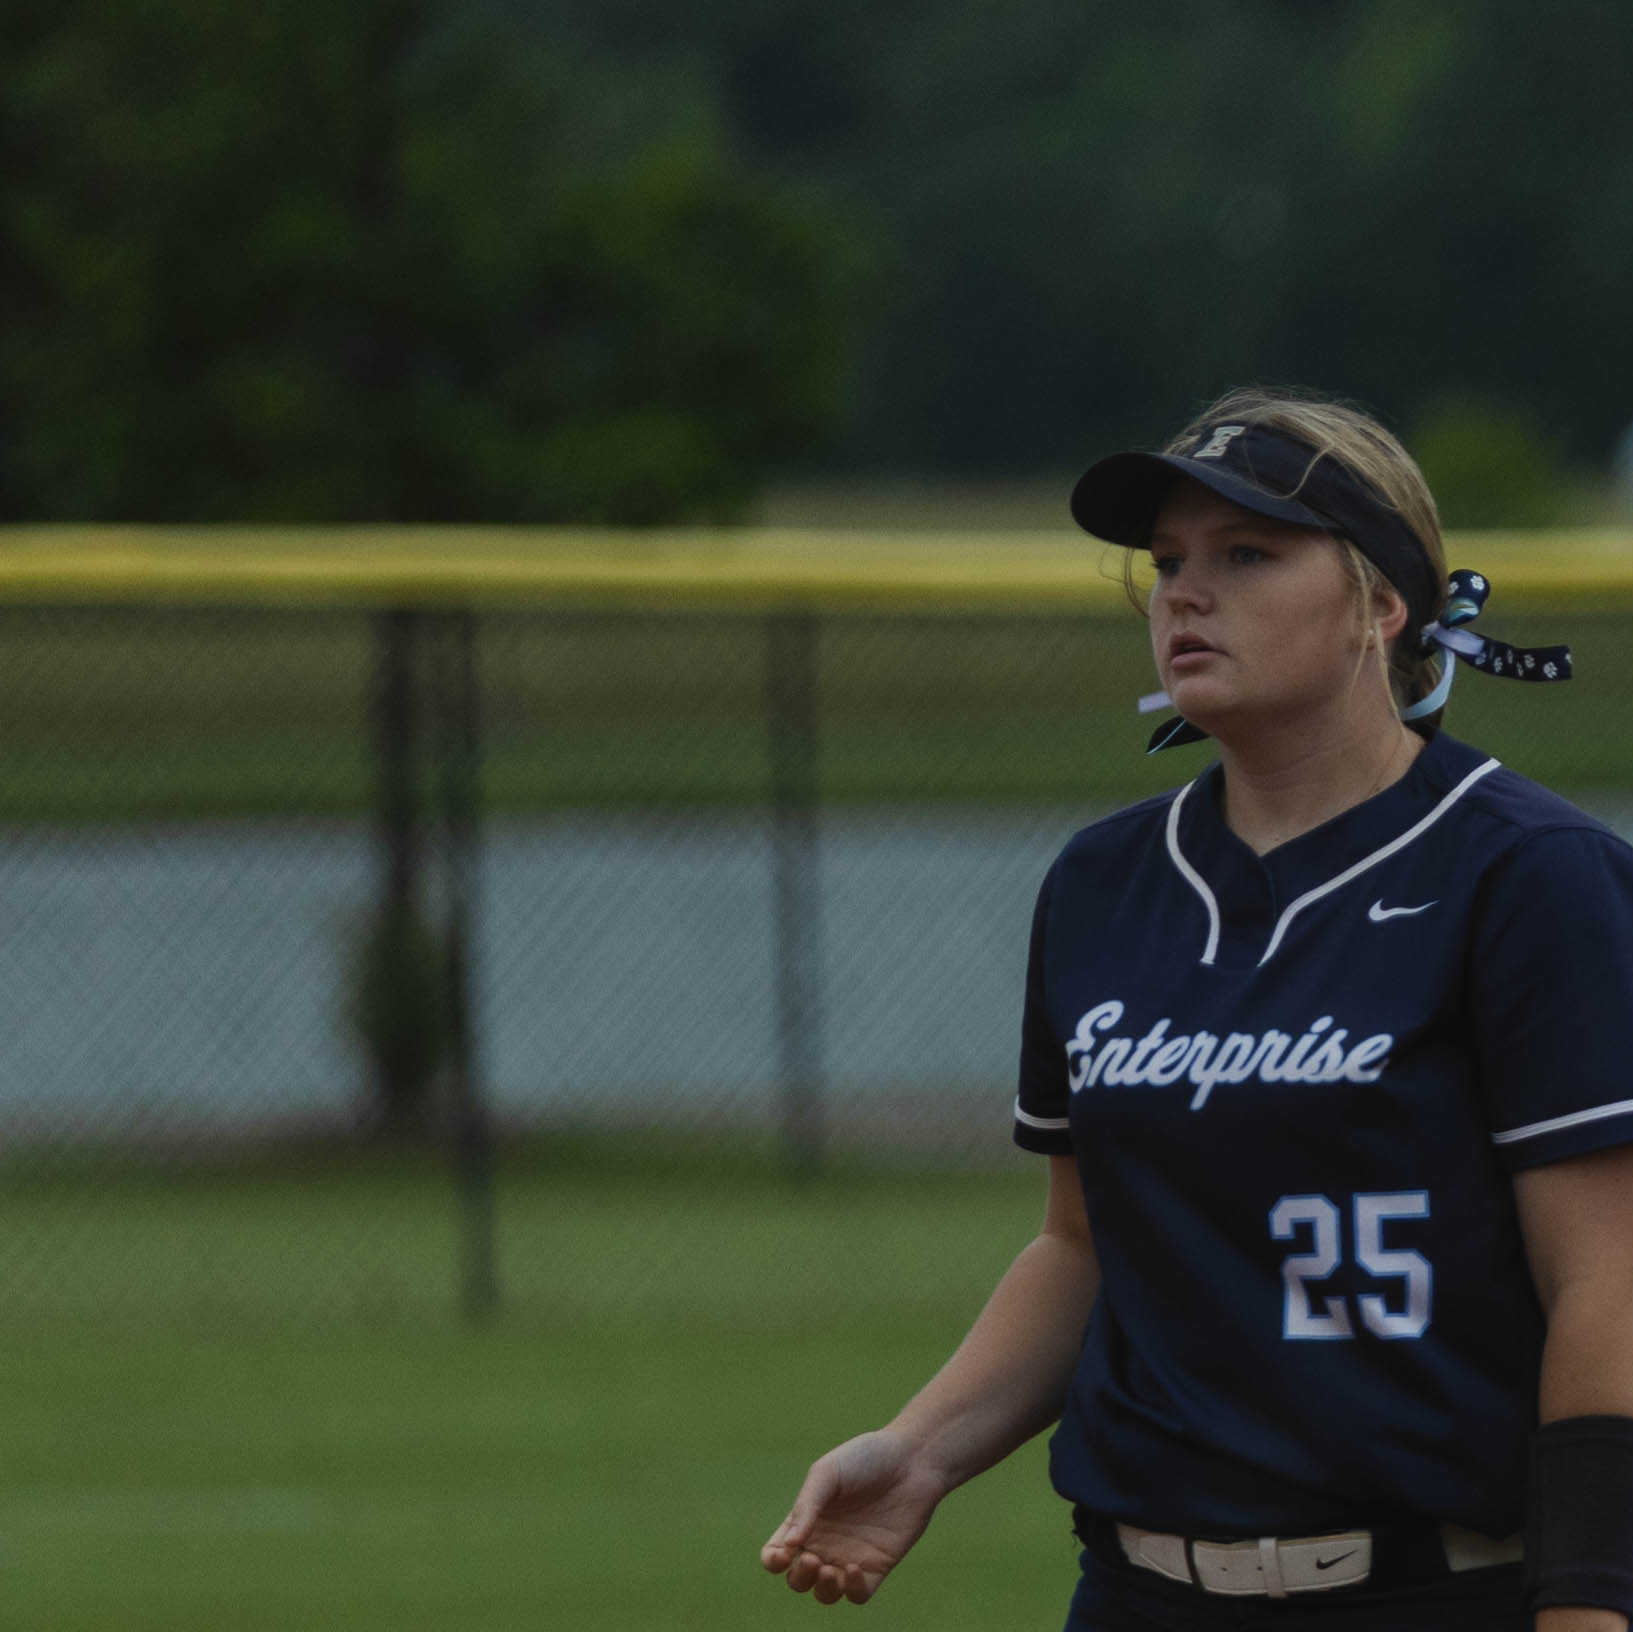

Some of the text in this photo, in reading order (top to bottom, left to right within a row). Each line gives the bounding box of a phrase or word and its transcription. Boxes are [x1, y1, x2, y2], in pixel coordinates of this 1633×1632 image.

[1193, 425, 1247, 458] E
[1065, 999, 1393, 1111] Enterprise
[1268, 1189, 1433, 1340] 25
